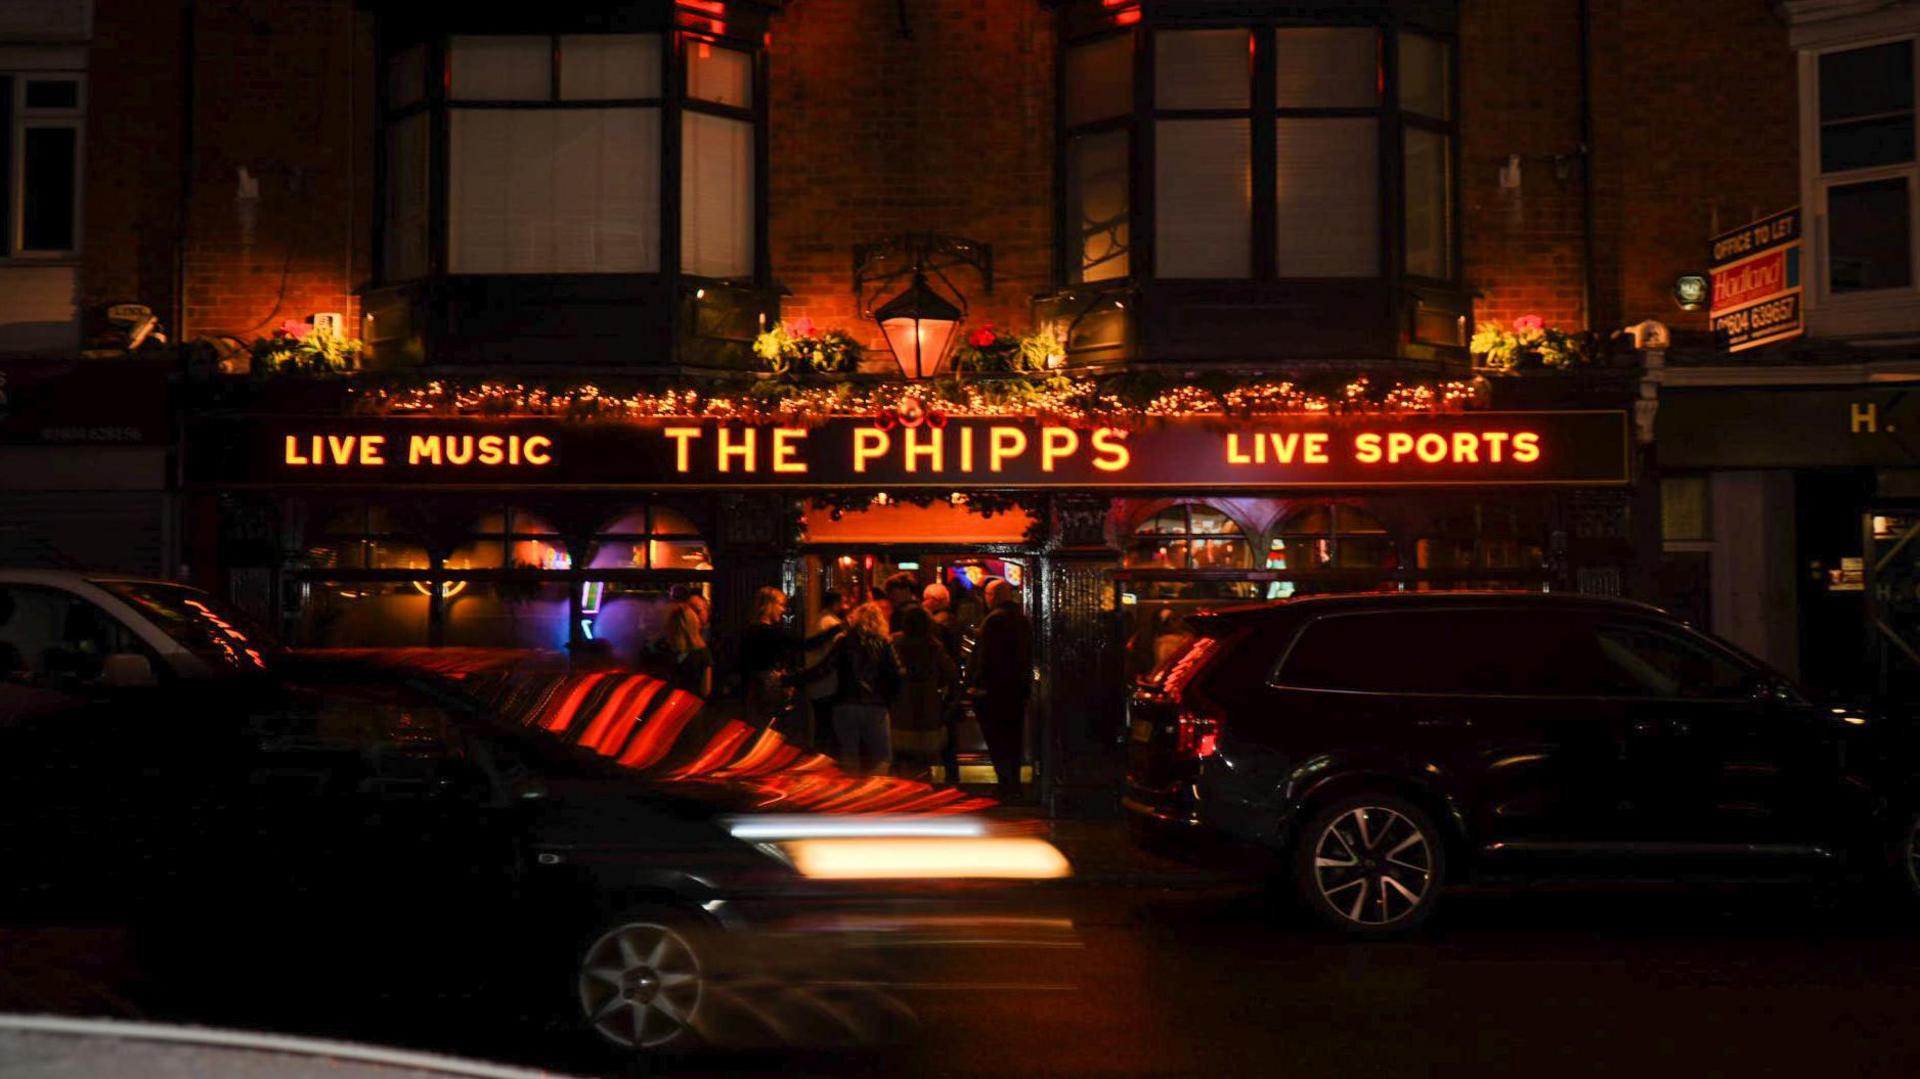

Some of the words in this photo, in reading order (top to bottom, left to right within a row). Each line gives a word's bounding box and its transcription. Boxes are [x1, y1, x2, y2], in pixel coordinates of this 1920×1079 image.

[1713, 231, 1751, 260] OFFICE
[1754, 224, 1770, 247] TO
[1772, 216, 1794, 241] LET
[284, 434, 384, 466] LIVE
[408, 434, 552, 466] MUSIC
[663, 426, 809, 473] THE
[853, 426, 1131, 473] PHIPPS
[1226, 432, 1330, 465] LIVE
[1354, 431, 1541, 464] SPORTS
